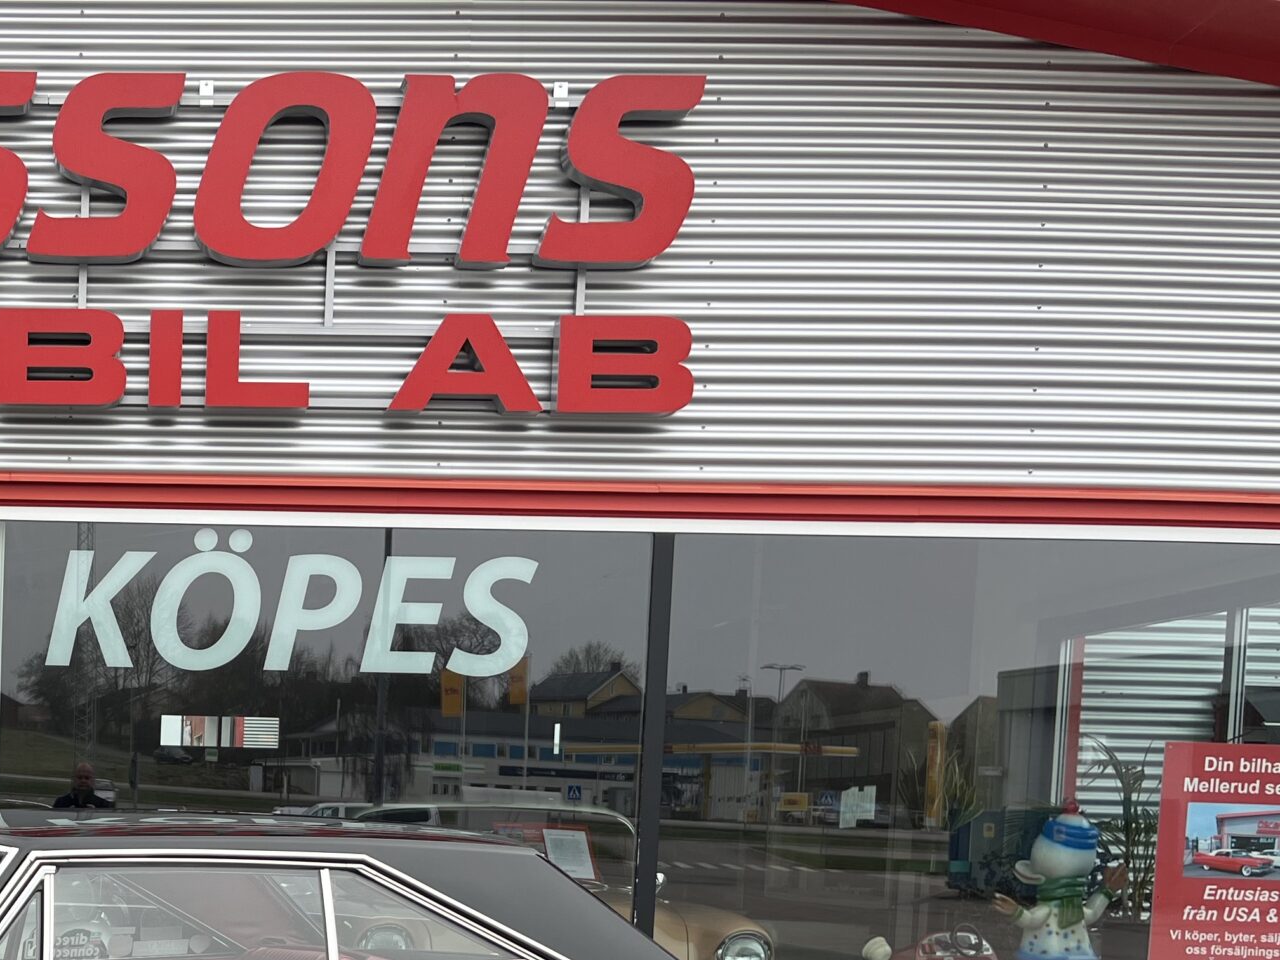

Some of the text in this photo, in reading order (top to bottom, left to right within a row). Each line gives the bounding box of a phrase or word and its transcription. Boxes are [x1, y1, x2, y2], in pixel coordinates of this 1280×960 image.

[385, 313, 696, 417] AB
[45, 528, 539, 677] KÖPES
[1204, 757, 1234, 772] Din
[1183, 778, 1261, 794] Mellerud
[1182, 905, 1279, 923] från USA &
[1170, 930, 1181, 940] Vi
[1185, 930, 1221, 943] köper,
[1225, 931, 1257, 944] byter,
[1185, 947, 1207, 955] oss
